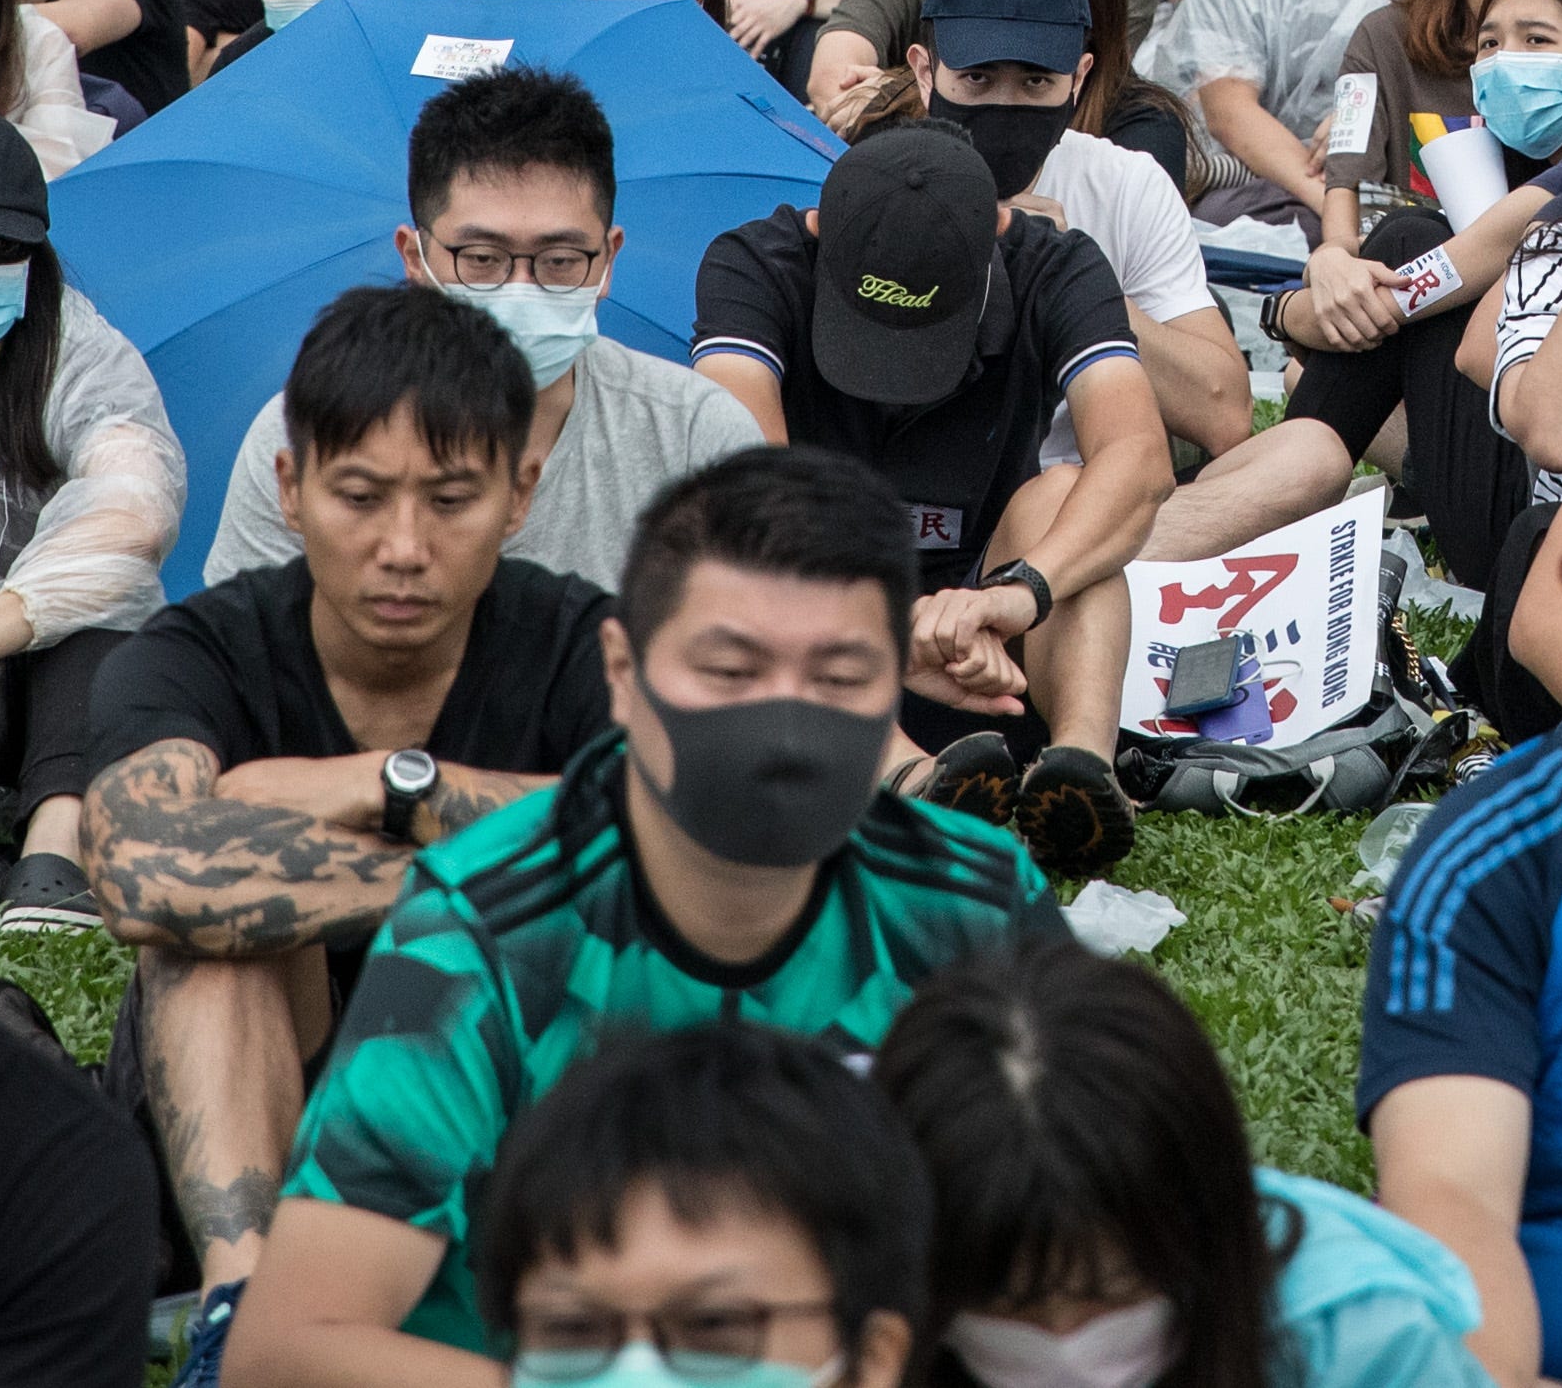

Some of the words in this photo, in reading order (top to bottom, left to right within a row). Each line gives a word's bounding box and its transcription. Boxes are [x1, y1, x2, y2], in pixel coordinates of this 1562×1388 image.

[858, 274, 939, 308] Head
[919, 511, 951, 541] 民
[1329, 519, 1357, 584] STRKIE
[1327, 577, 1355, 616] FOR
[1324, 616, 1353, 663] HONG
[1321, 661, 1350, 709] KONG
